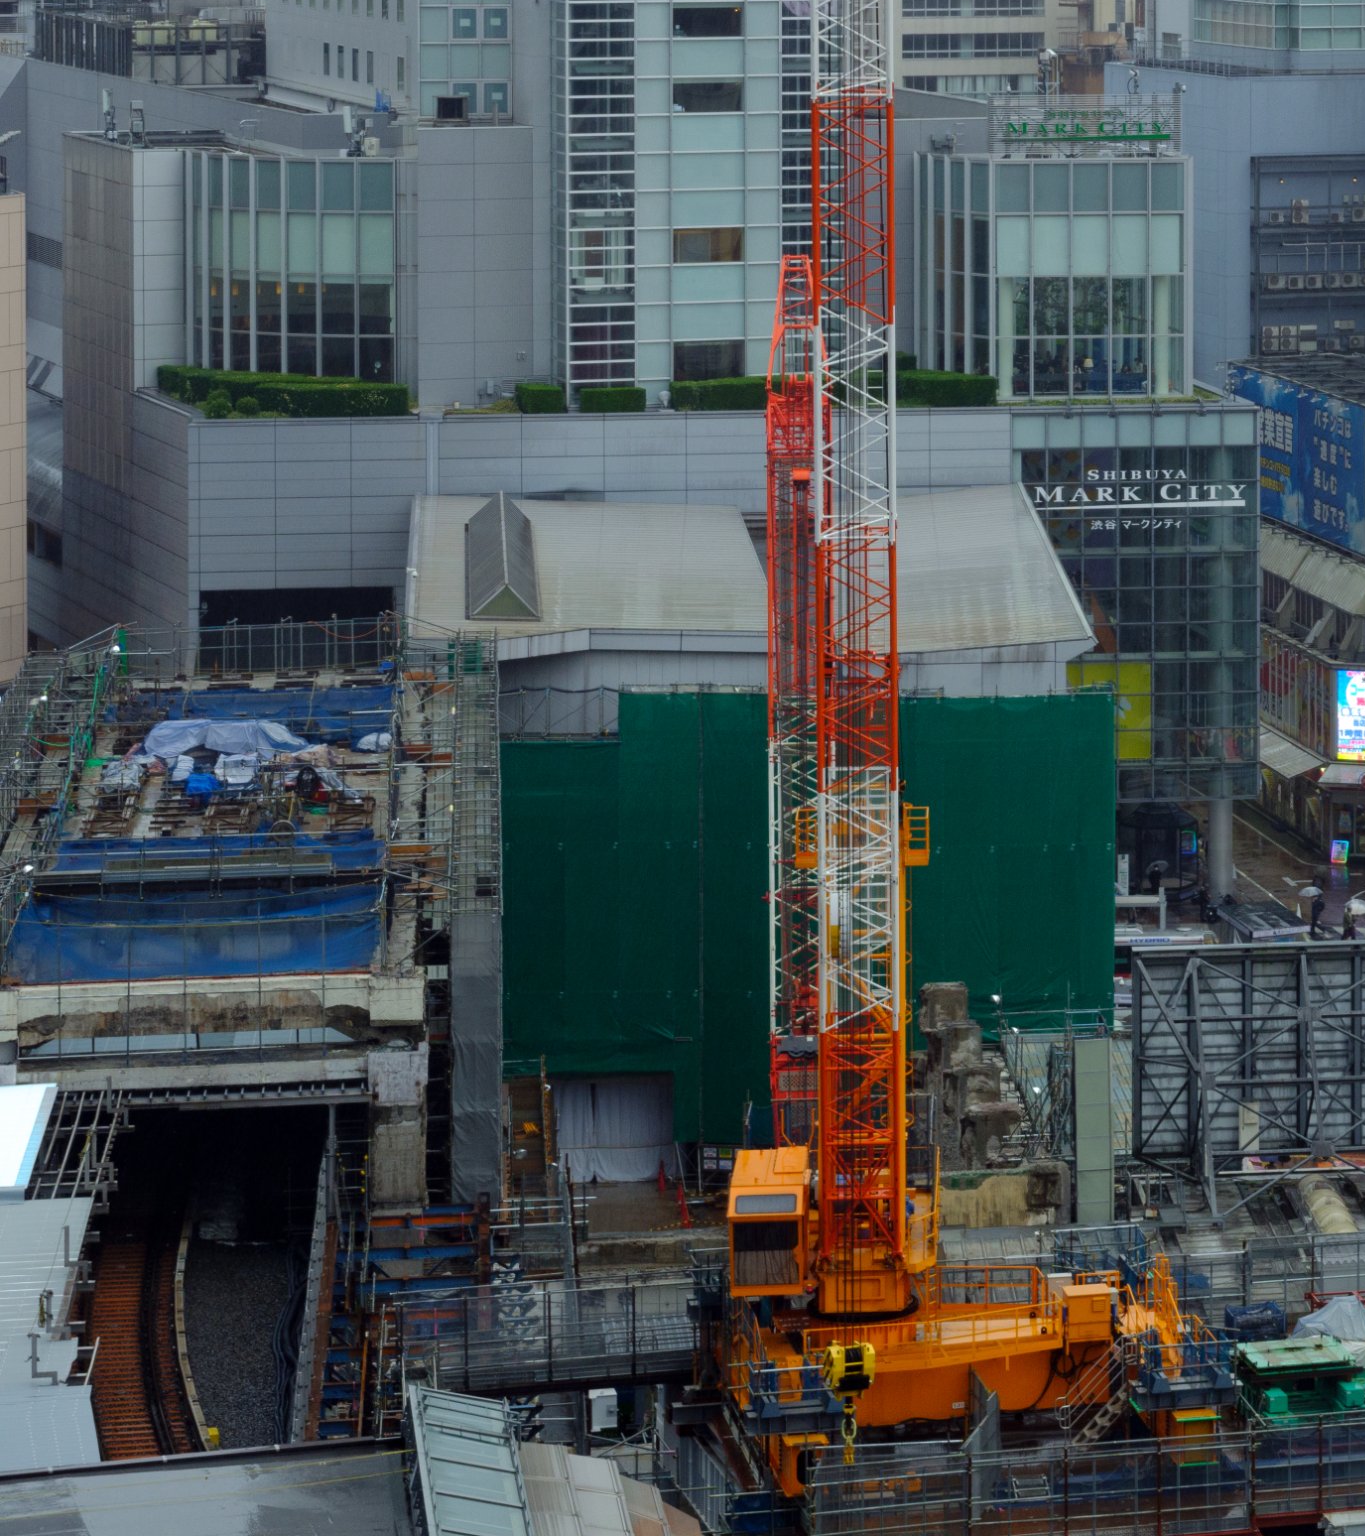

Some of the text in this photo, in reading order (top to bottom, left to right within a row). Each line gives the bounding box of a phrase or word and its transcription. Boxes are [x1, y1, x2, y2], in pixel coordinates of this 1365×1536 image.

[1087, 468, 1188, 481] SHIBUYA
[1035, 487, 1143, 504] MARK
[1160, 483, 1246, 502] CITY
[1091, 518, 1182, 531] 渋谷 マークシティ
